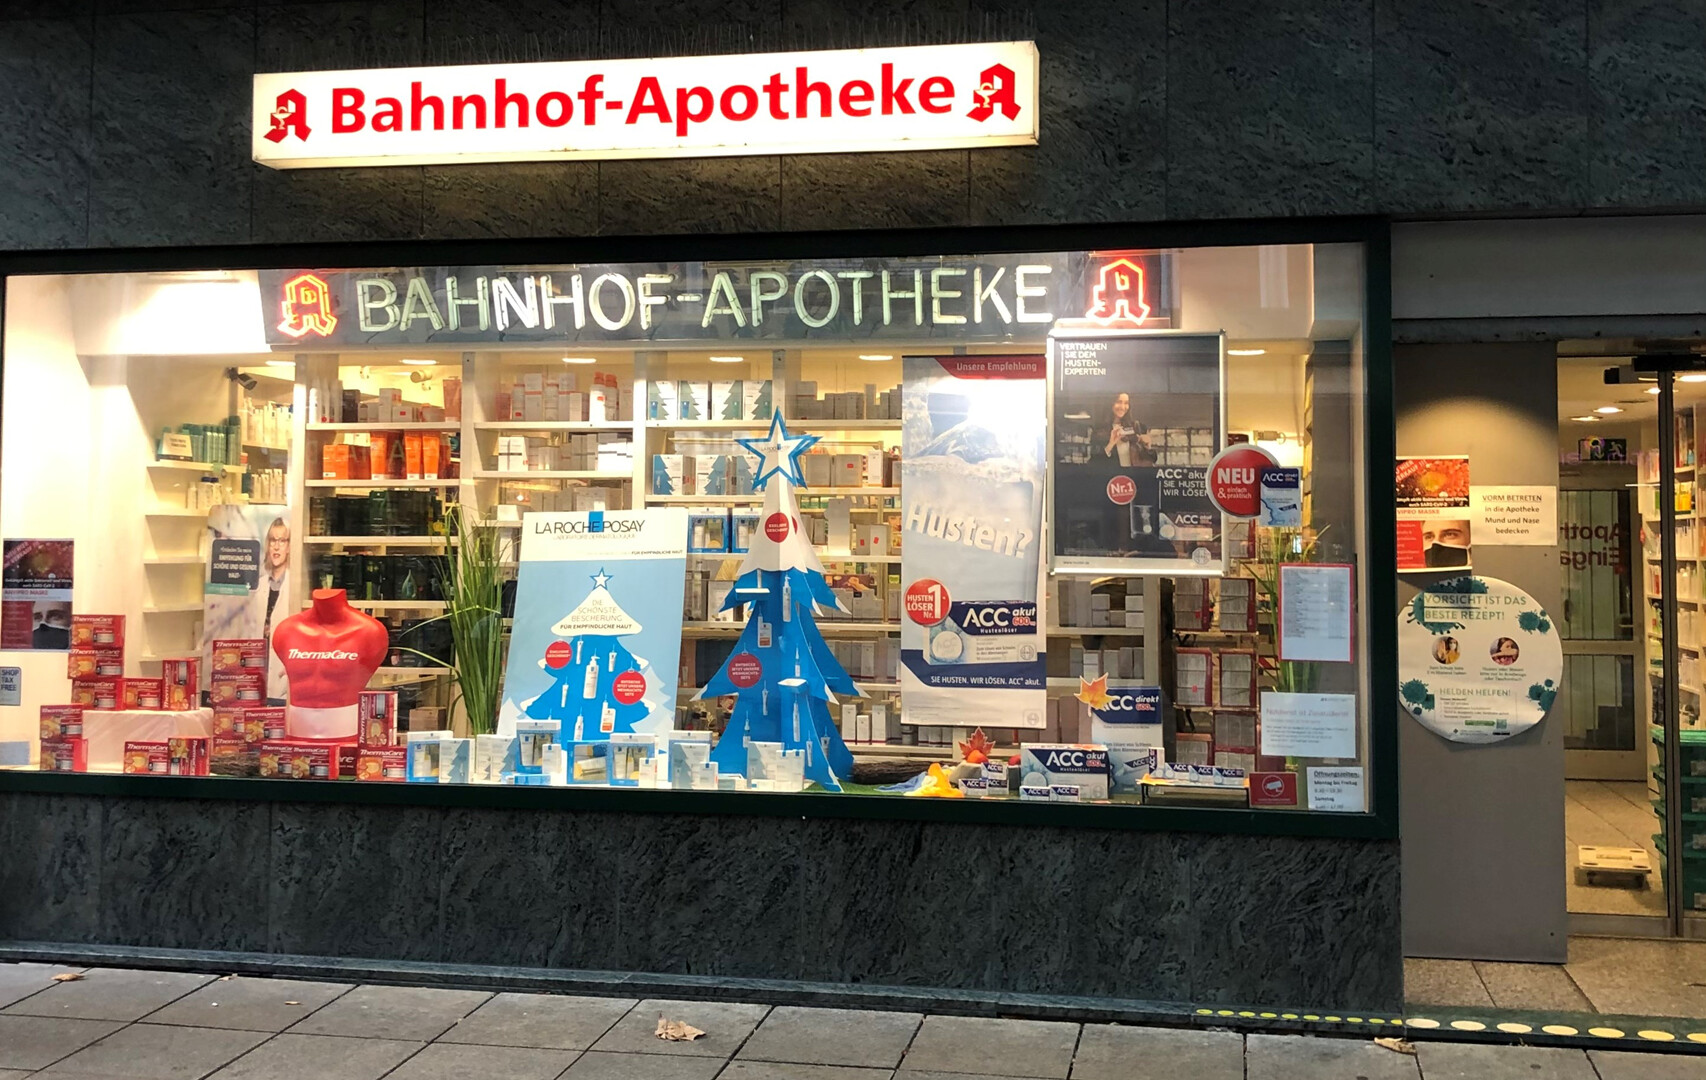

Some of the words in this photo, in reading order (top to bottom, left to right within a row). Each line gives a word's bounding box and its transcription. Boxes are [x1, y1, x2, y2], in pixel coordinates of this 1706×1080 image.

[331, 62, 955, 137] Bahnhof-Apotheke
[356, 264, 1053, 333] BAHNHOF-APOTHEKE
[1059, 342, 1108, 351] VERTRAUEN
[1064, 350, 1077, 359] SIE
[1078, 350, 1097, 359] DEM
[956, 362, 986, 371] Unsere
[987, 361, 1037, 372] Empfehlung
[1064, 359, 1102, 368] HUSTEN-
[1064, 367, 1107, 376] EXPERTEN!
[1188, 470, 1206, 480] aku
[1217, 467, 1255, 485] NEU
[1262, 472, 1284, 482] ACC
[1163, 480, 1176, 488] SIE
[1178, 480, 1206, 489] HUSTE
[1163, 488, 1180, 497] WIR
[1217, 487, 1227, 499] &
[1227, 492, 1252, 500] praktisch
[1505, 506, 1540, 514] Apotheke
[1175, 514, 1199, 525] ACC
[1522, 517, 1540, 525] Nase
[535, 521, 552, 534] LA
[553, 520, 601, 534] ROCHE
[602, 519, 646, 533] POSAY
[905, 502, 1034, 560] Husten?
[907, 594, 934, 602] HUSTEN
[1424, 594, 1485, 605] VORSICHT
[1485, 595, 1502, 605] IST
[1504, 595, 1528, 606] DAS
[577, 606, 617, 614] SCHÖNSTE
[907, 601, 934, 612] LÖSER
[73, 616, 113, 624] ThermaCare
[571, 614, 623, 622] BESCHERUNG
[923, 611, 934, 619] Nr.
[962, 607, 1009, 628] ACC
[1012, 606, 1036, 617] akut
[1425, 610, 1458, 620] BESTE
[1460, 610, 1505, 621] REZEPT!
[288, 648, 359, 661] ThermaCare
[163, 661, 171, 709] ThermaCare
[930, 675, 941, 684] SIE
[941, 675, 969, 685] HUSTEN.
[970, 676, 984, 685] WIR
[985, 676, 1007, 686] LÖSEN.
[1024, 678, 1042, 687] akut.
[1439, 688, 1474, 696] HELDEN
[1475, 689, 1511, 697] HELFEN!
[1135, 695, 1159, 703] direkt
[360, 748, 405, 757] ThermaCare
[1045, 751, 1084, 767] ACC
[1086, 752, 1106, 760] akut
